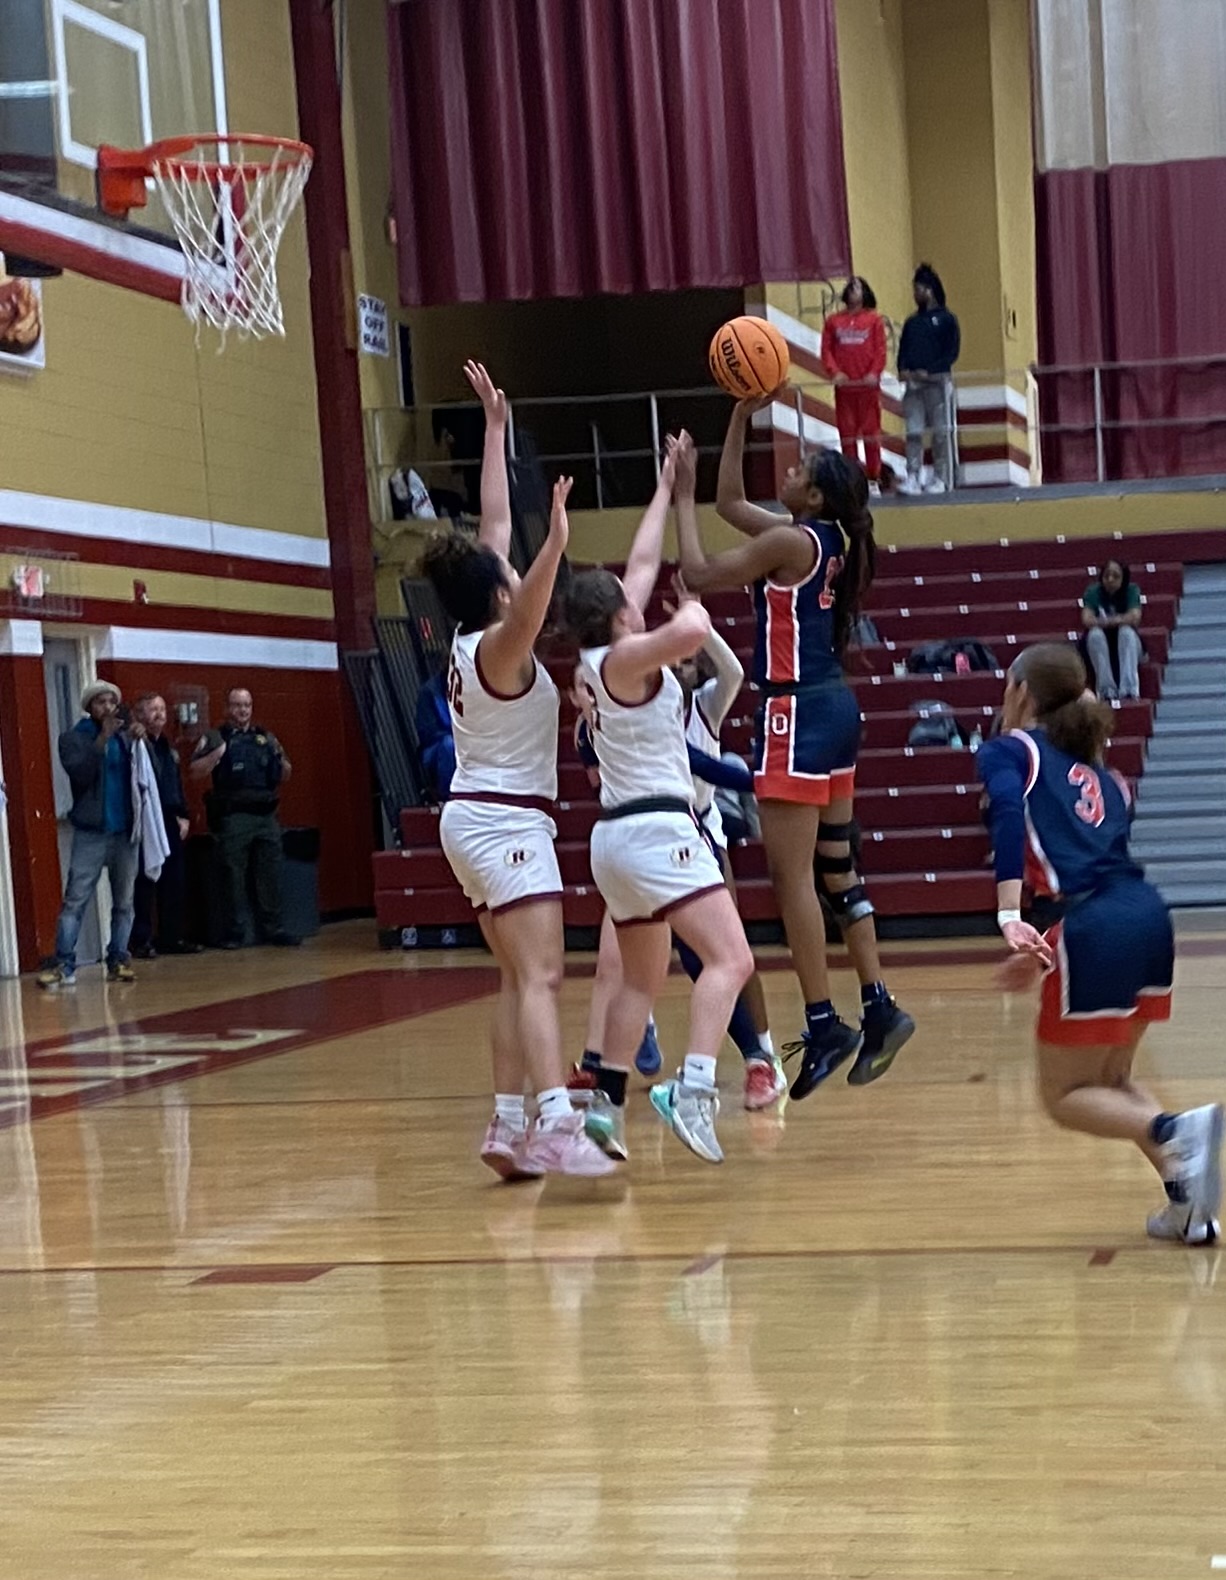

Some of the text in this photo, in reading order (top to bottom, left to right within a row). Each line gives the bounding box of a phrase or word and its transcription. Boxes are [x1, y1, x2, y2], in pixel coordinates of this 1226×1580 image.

[365, 316, 384, 332] OFF
[721, 337, 752, 392] Wilson
[1067, 762, 1105, 828] 3
